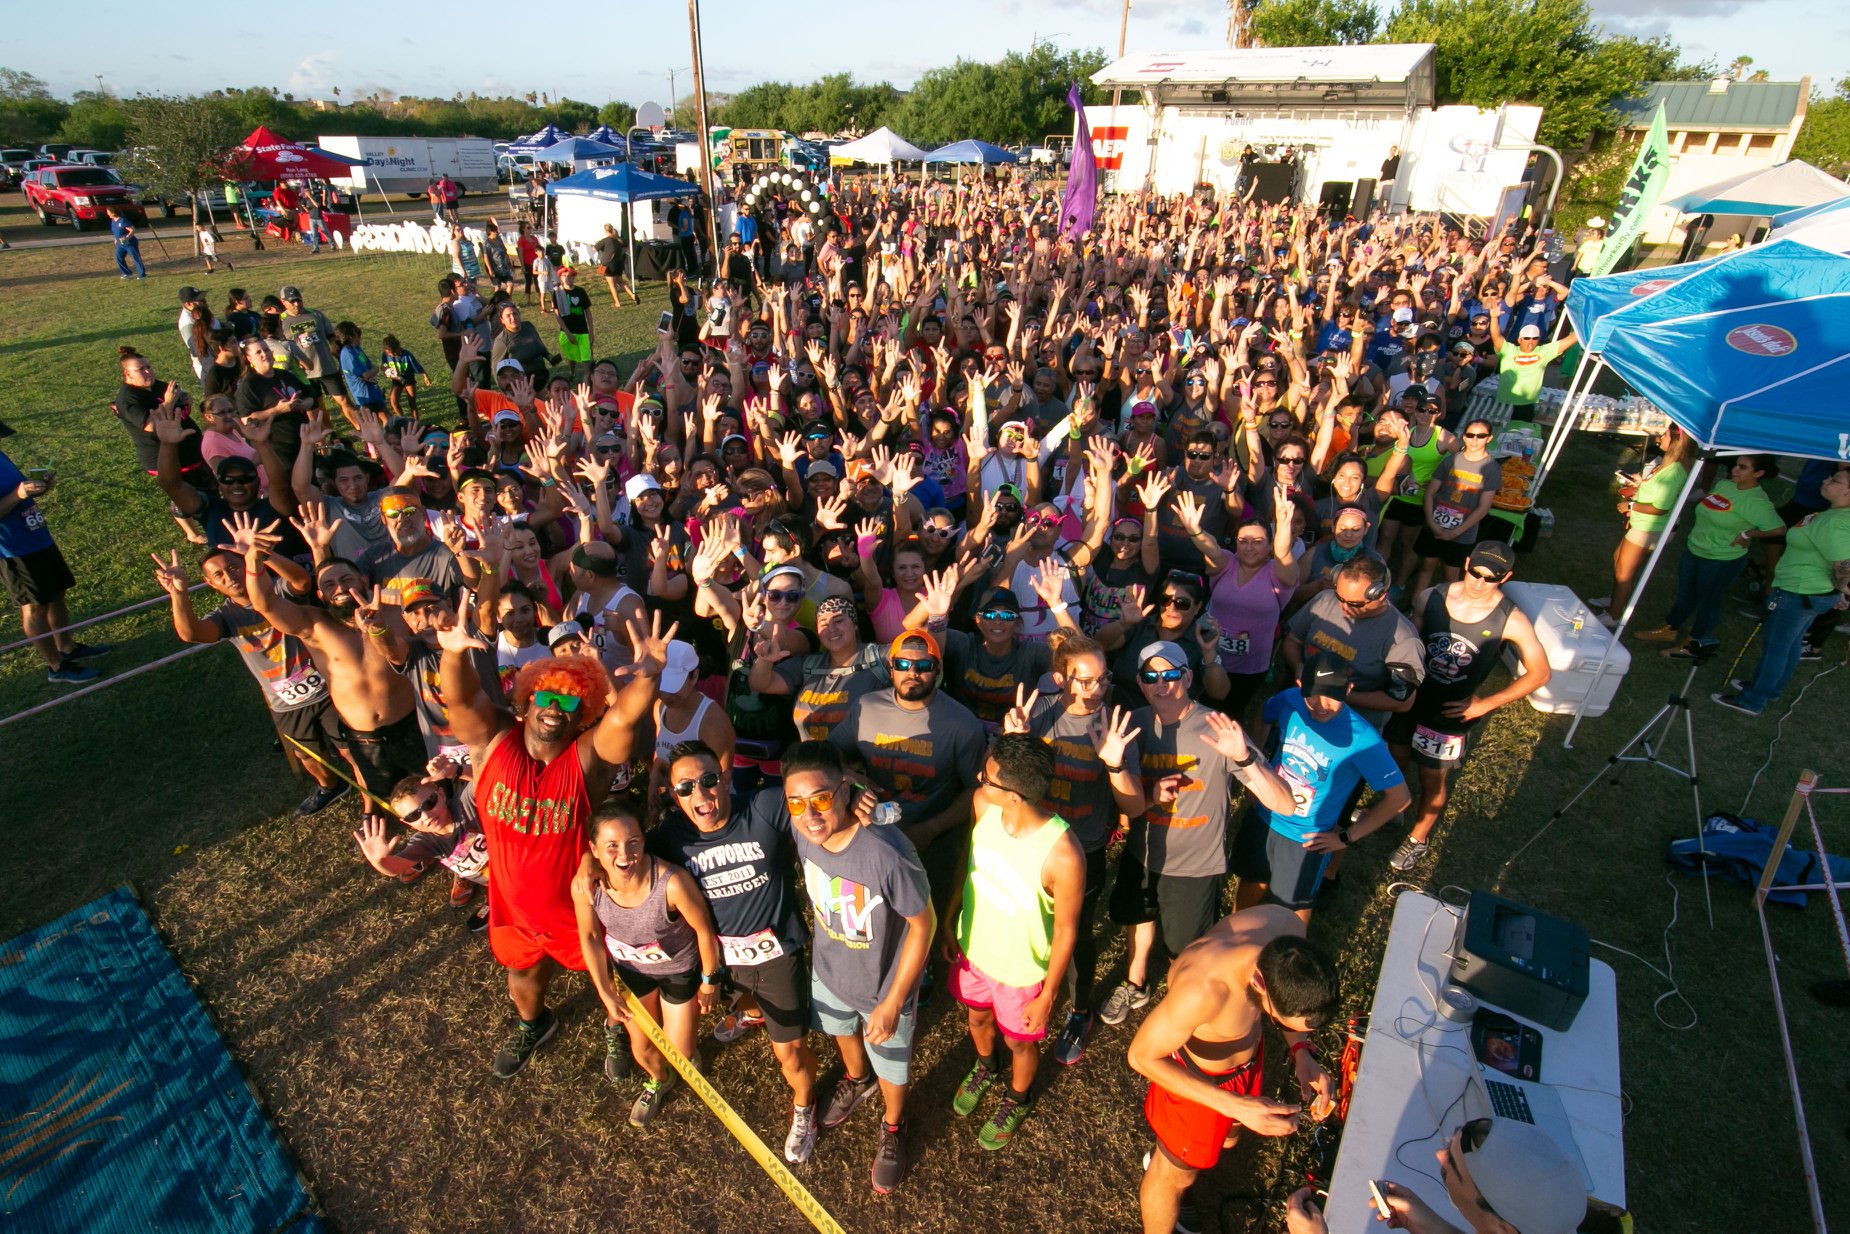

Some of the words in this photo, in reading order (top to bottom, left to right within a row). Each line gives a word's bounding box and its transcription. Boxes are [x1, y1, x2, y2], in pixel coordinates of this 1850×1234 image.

[367, 157, 415, 167] Day&Night
[1604, 145, 1660, 240] ORKS
[1594, 214, 1643, 277] otworksrgv.com
[26, 512, 43, 527] 66
[1434, 511, 1460, 527] 205
[281, 674, 321, 701] 309
[874, 732, 934, 757] FOOTWORKS
[1417, 736, 1456, 757] 311
[728, 867, 752, 881] 2011
[706, 871, 770, 899] ARLINGEN
[615, 946, 663, 961] 110
[729, 939, 775, 960] 109
